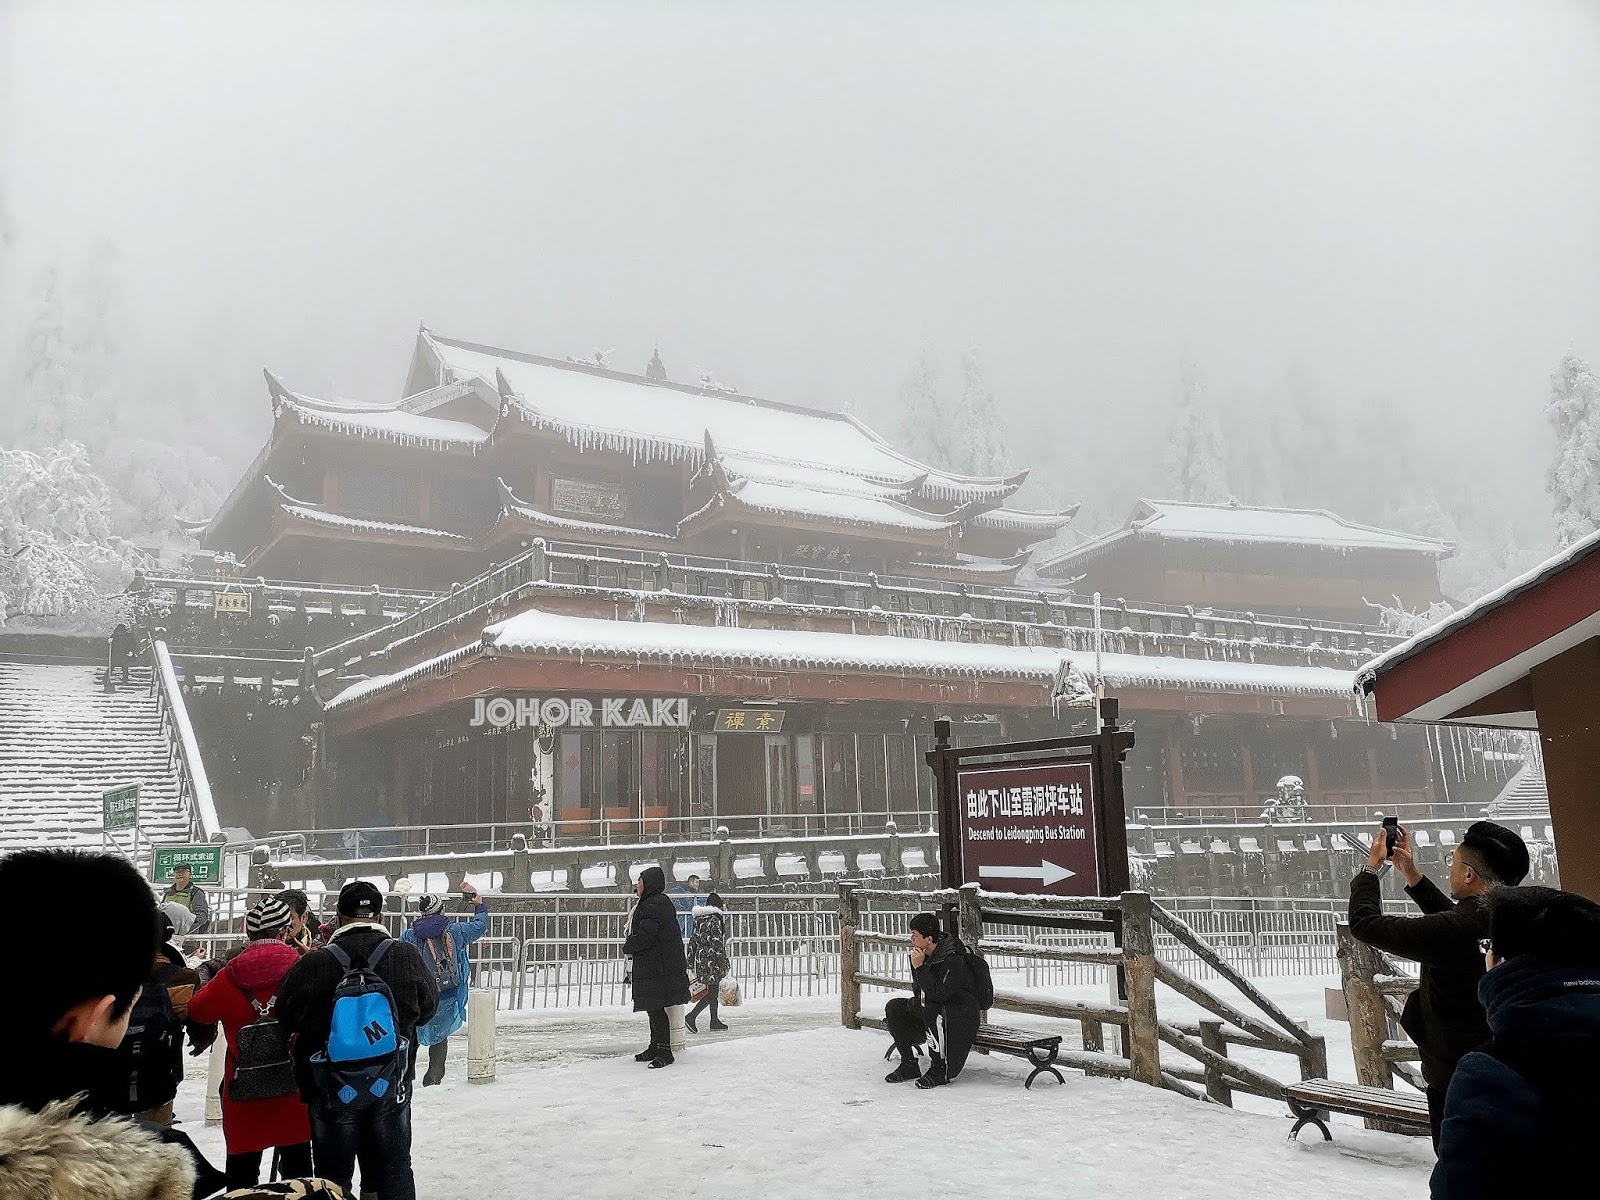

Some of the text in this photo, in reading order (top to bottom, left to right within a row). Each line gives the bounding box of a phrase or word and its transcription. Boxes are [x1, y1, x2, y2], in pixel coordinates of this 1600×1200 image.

[967, 783, 1084, 818] 由此下山至雷洞坪车站
[968, 825, 1086, 844] Descend to Leidongping Bus Station
[363, 1020, 388, 1046] M
